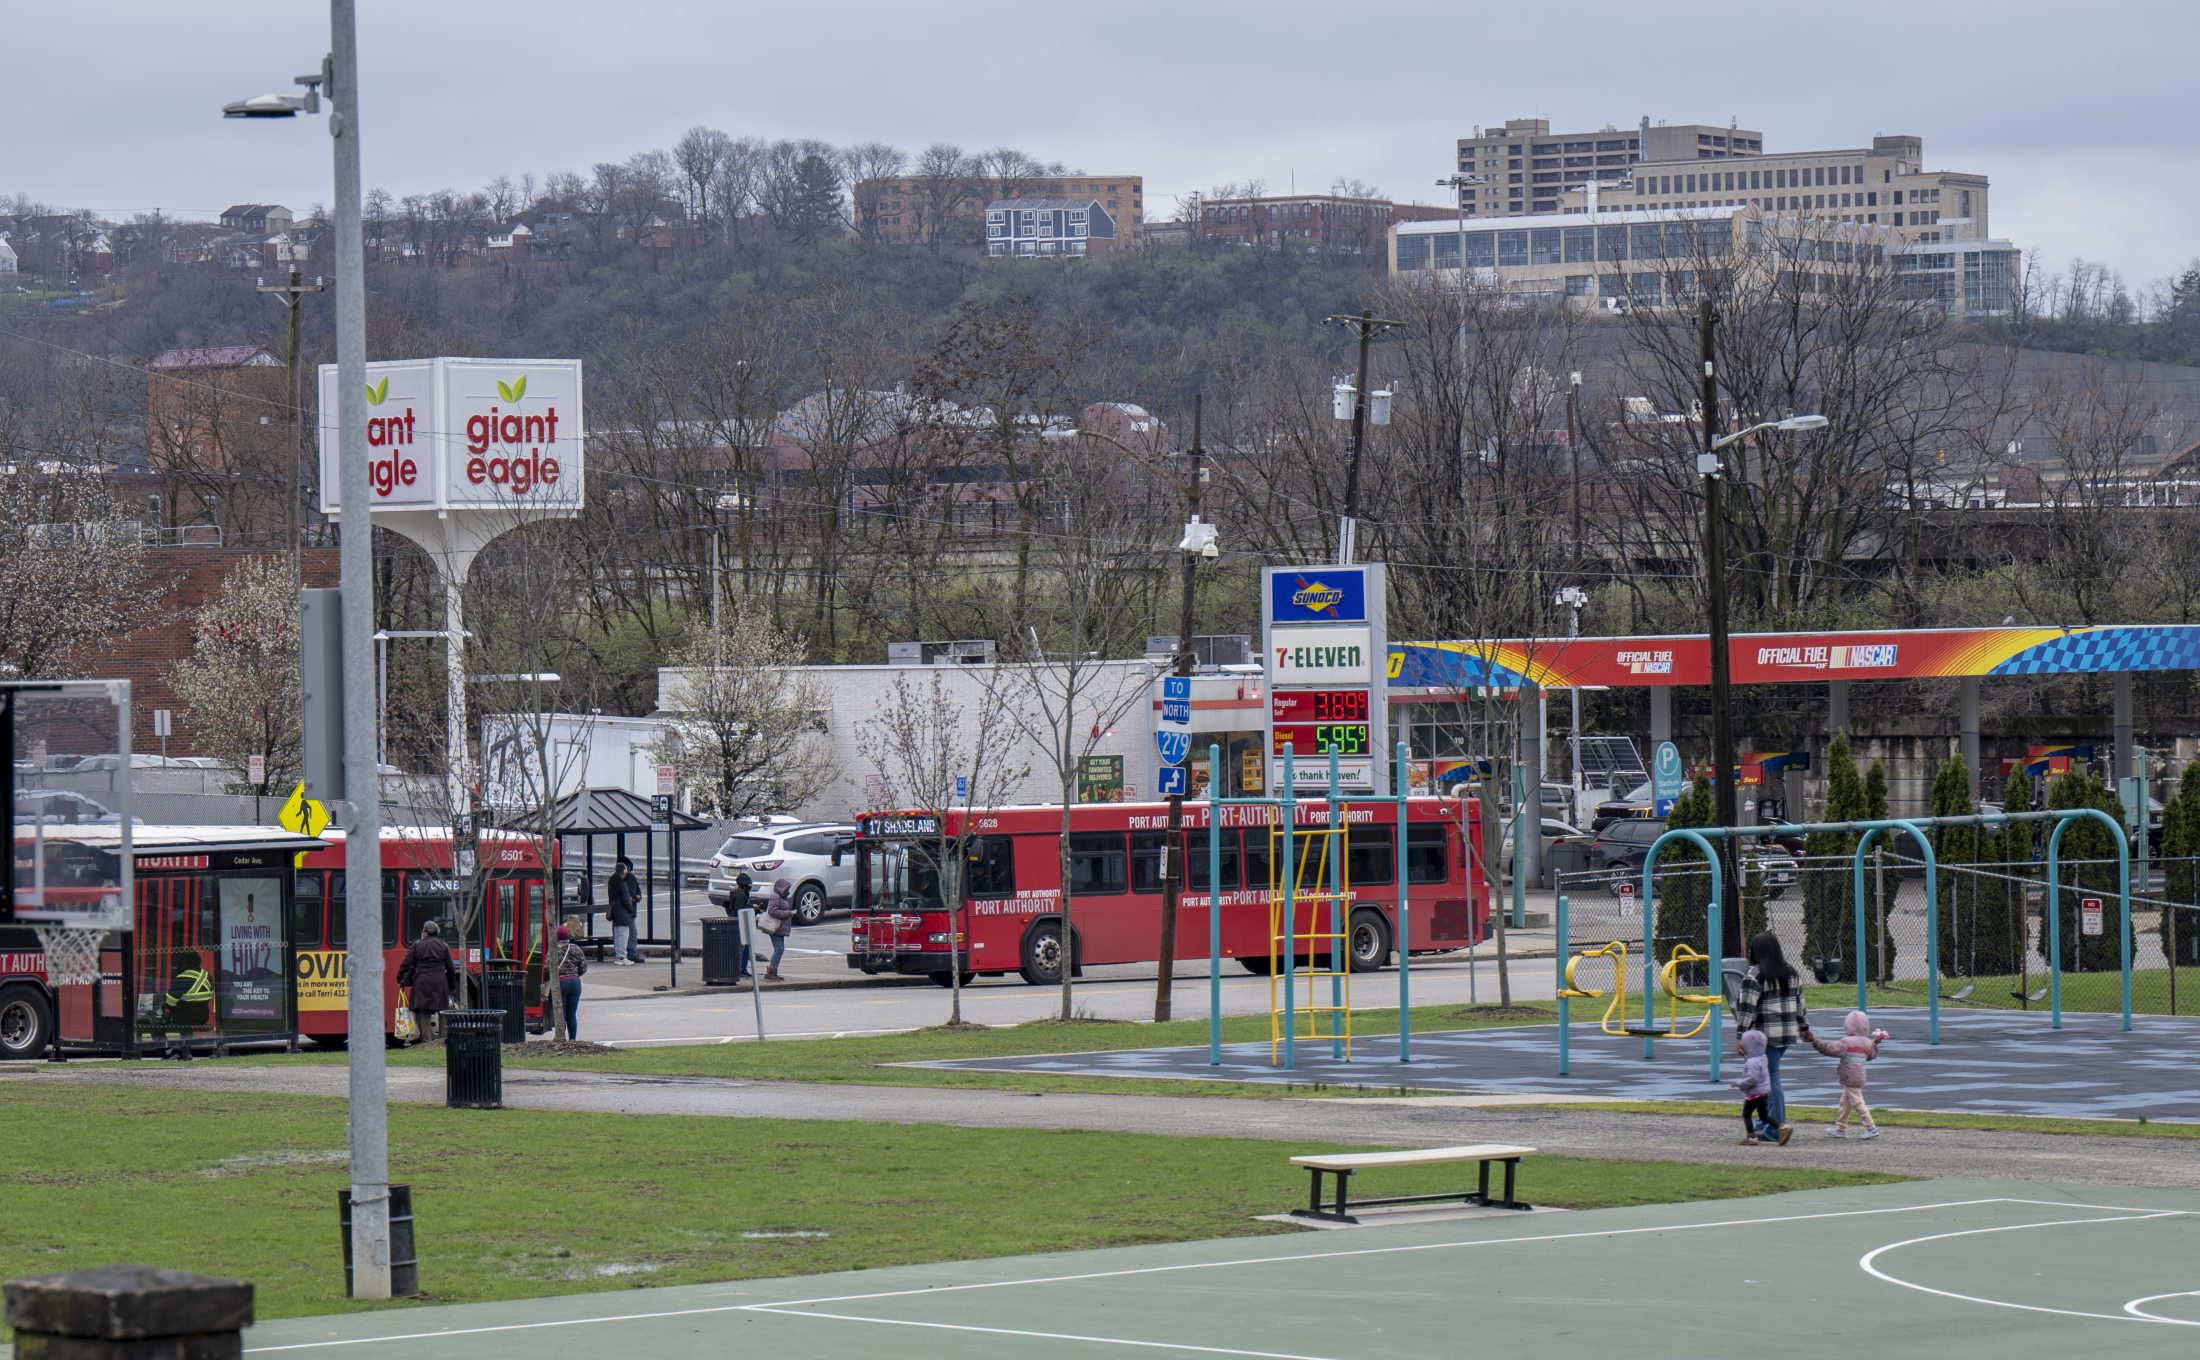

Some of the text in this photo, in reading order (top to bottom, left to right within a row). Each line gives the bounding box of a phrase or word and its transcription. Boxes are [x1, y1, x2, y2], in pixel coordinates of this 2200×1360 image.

[367, 407, 416, 446] ant
[466, 406, 559, 454] giant
[466, 447, 560, 494] eagle
[1294, 590, 1341, 604] SUNOCO
[1616, 650, 1673, 663] OFFICIAL FUEL
[1757, 645, 1894, 667] OFFICIAL FUEL NASCAR
[1643, 662, 1671, 673] NASCAR
[1170, 681, 1184, 694] TO
[1273, 698, 1297, 707] Regular
[1163, 704, 1189, 717] NORTH
[1274, 731, 1294, 740] Diesel
[1161, 732, 1190, 757] 279
[1299, 769, 1324, 780] thank
[1325, 768, 1361, 780] haven!
[1129, 816, 1150, 829] PORT
[1201, 806, 1235, 827] PRT
[1310, 811, 1330, 824] PORT
[869, 820, 881, 835] 17
[233, 856, 263, 864] Cedar Ave.
[1016, 889, 1061, 899] PORT AUTHORITY
[1182, 897, 1199, 907] PORT
[1233, 891, 1257, 905] PORT
[975, 899, 1056, 916] PORT AUTHORITY
[231, 925, 271, 939] LIVING WITH
[317, 990, 333, 998] Terri
